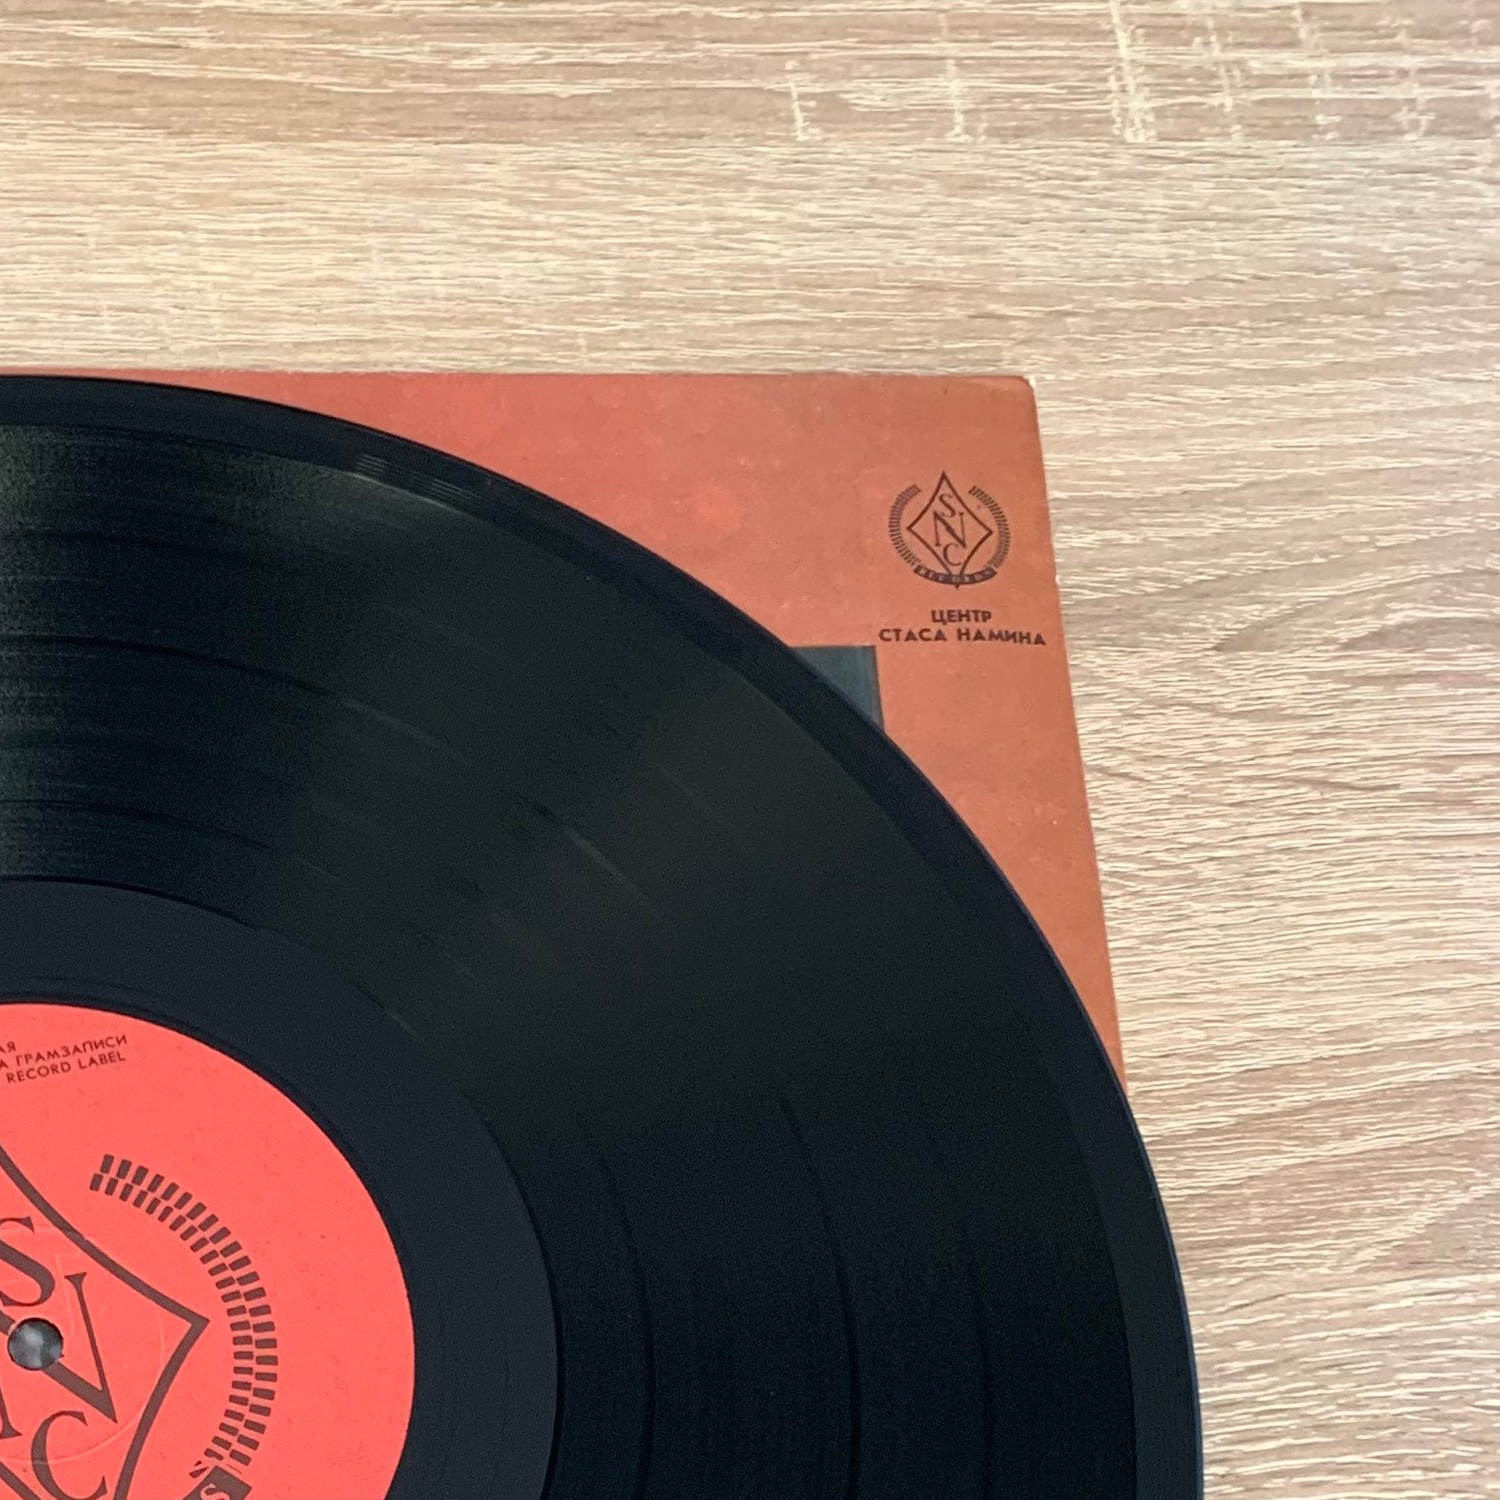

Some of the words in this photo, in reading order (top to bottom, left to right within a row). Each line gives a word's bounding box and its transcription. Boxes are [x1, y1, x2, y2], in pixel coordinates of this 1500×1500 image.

[931, 609, 992, 625] ЦЕНТР
[878, 628, 948, 642] СТАСА
[956, 628, 1047, 646] НАМИНА
[16, 1034, 128, 1066] ГРАМЗАПИСИ
[6, 1061, 71, 1084] RECORD
[77, 1050, 127, 1070] LABEL
